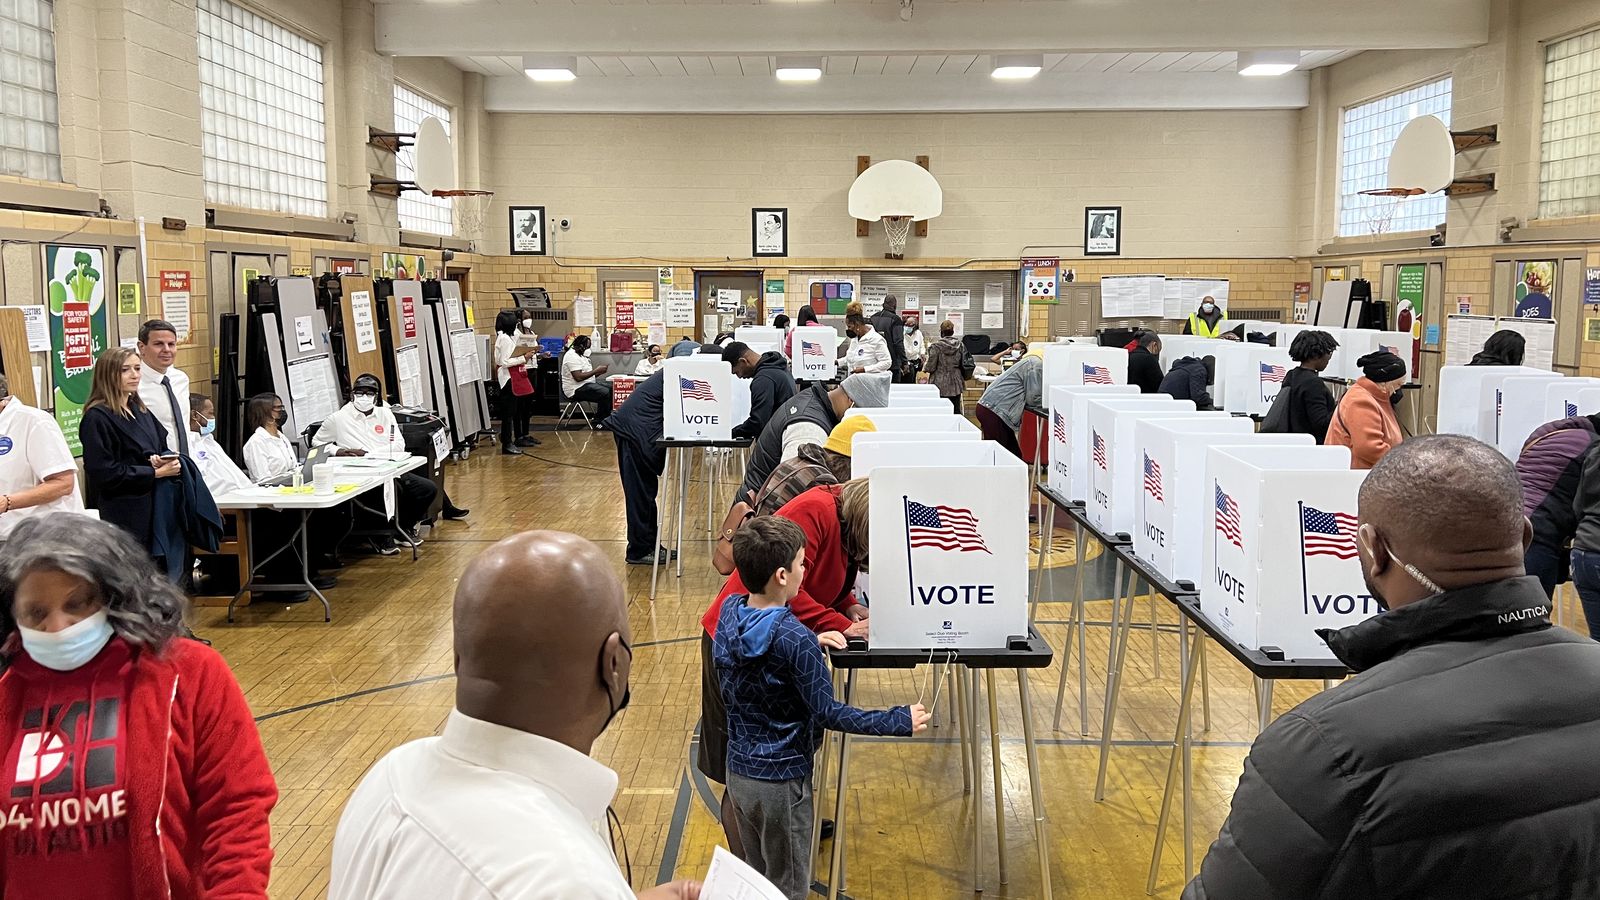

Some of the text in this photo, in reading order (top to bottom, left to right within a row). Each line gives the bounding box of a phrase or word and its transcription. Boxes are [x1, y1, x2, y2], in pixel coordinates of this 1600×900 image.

[1522, 306, 1540, 318] DOES
[686, 415, 718, 424] VOTE
[1056, 462, 1067, 477] VOTE
[1095, 488, 1108, 510] VOTE
[1146, 521, 1164, 548] VOTE
[1218, 566, 1244, 604] VOTE
[918, 586, 994, 605] VOTE
[1498, 605, 1548, 624] NAUTICA
